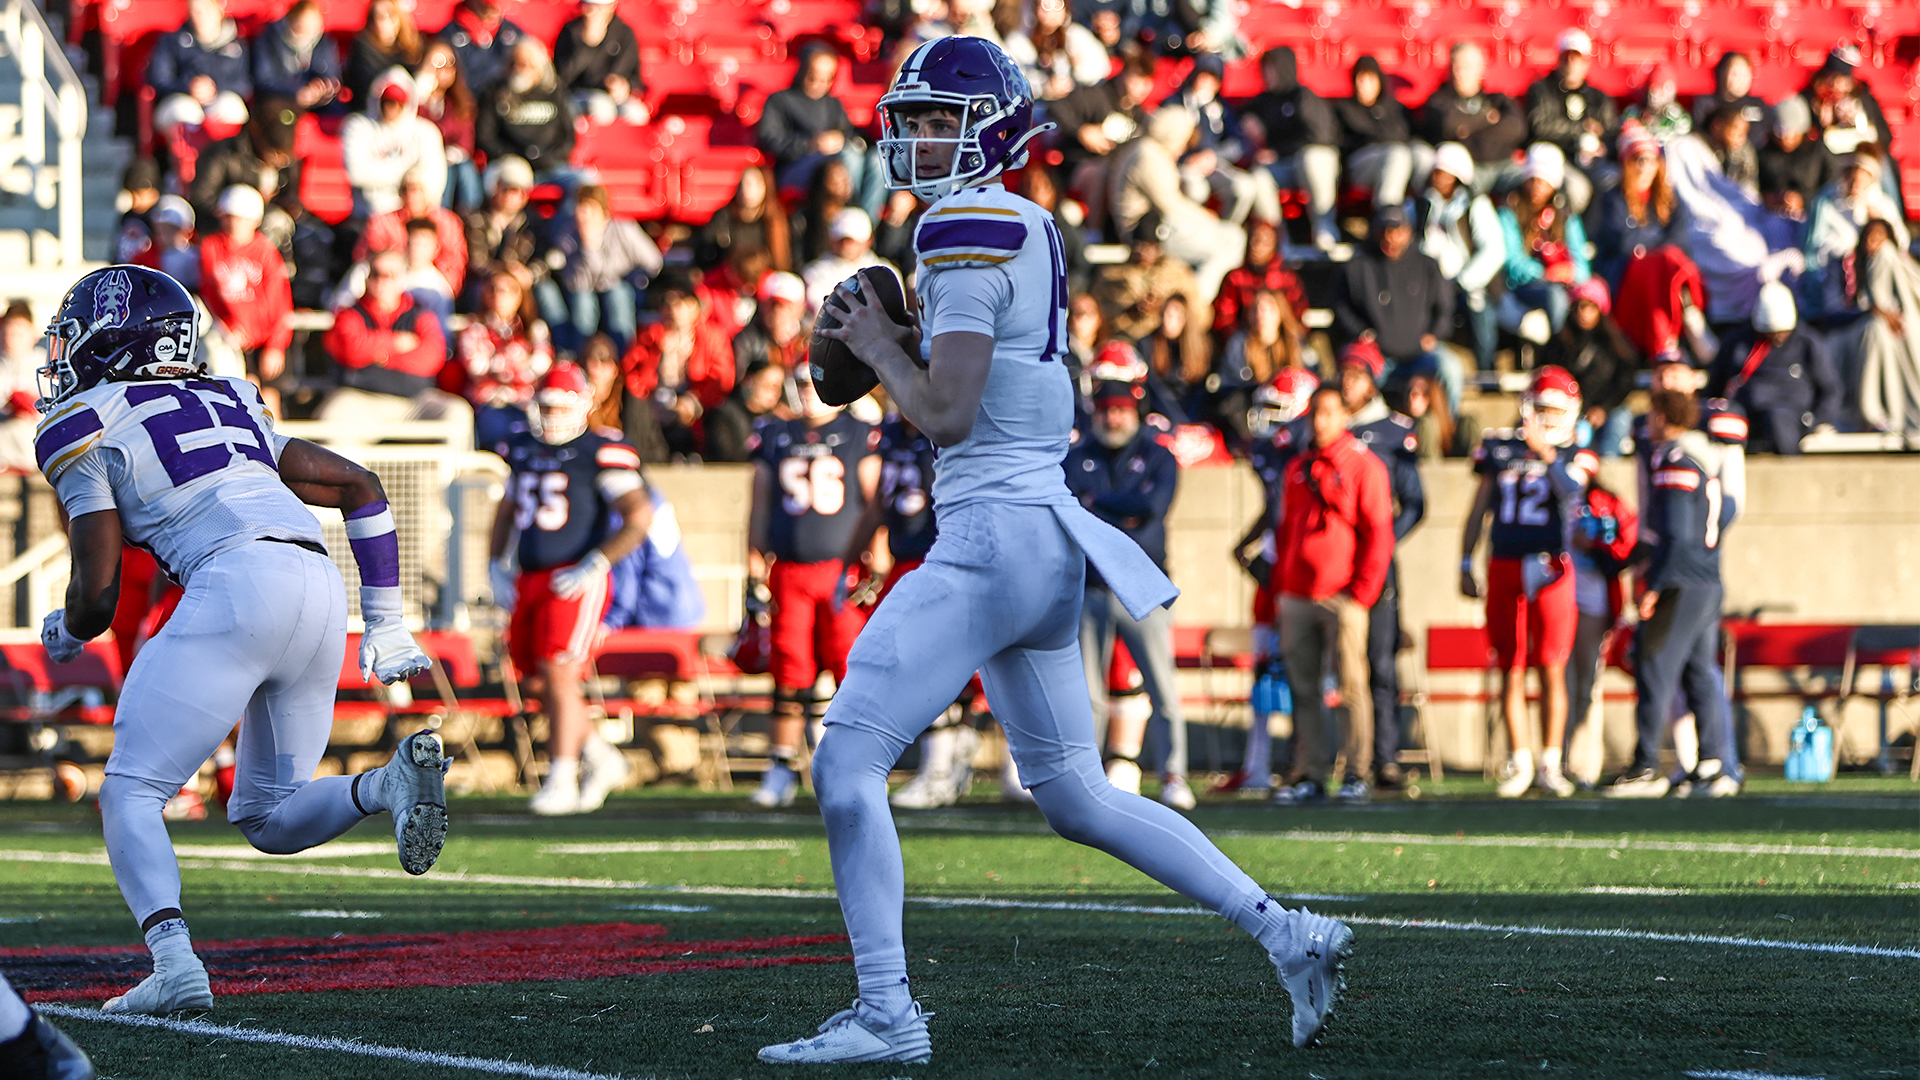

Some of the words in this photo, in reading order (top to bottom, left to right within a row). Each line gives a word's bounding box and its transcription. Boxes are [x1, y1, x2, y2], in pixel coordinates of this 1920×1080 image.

[124, 379, 279, 488] 23
[514, 471, 570, 532] 55
[778, 455, 845, 515] 56
[1497, 469, 1549, 526] 12
